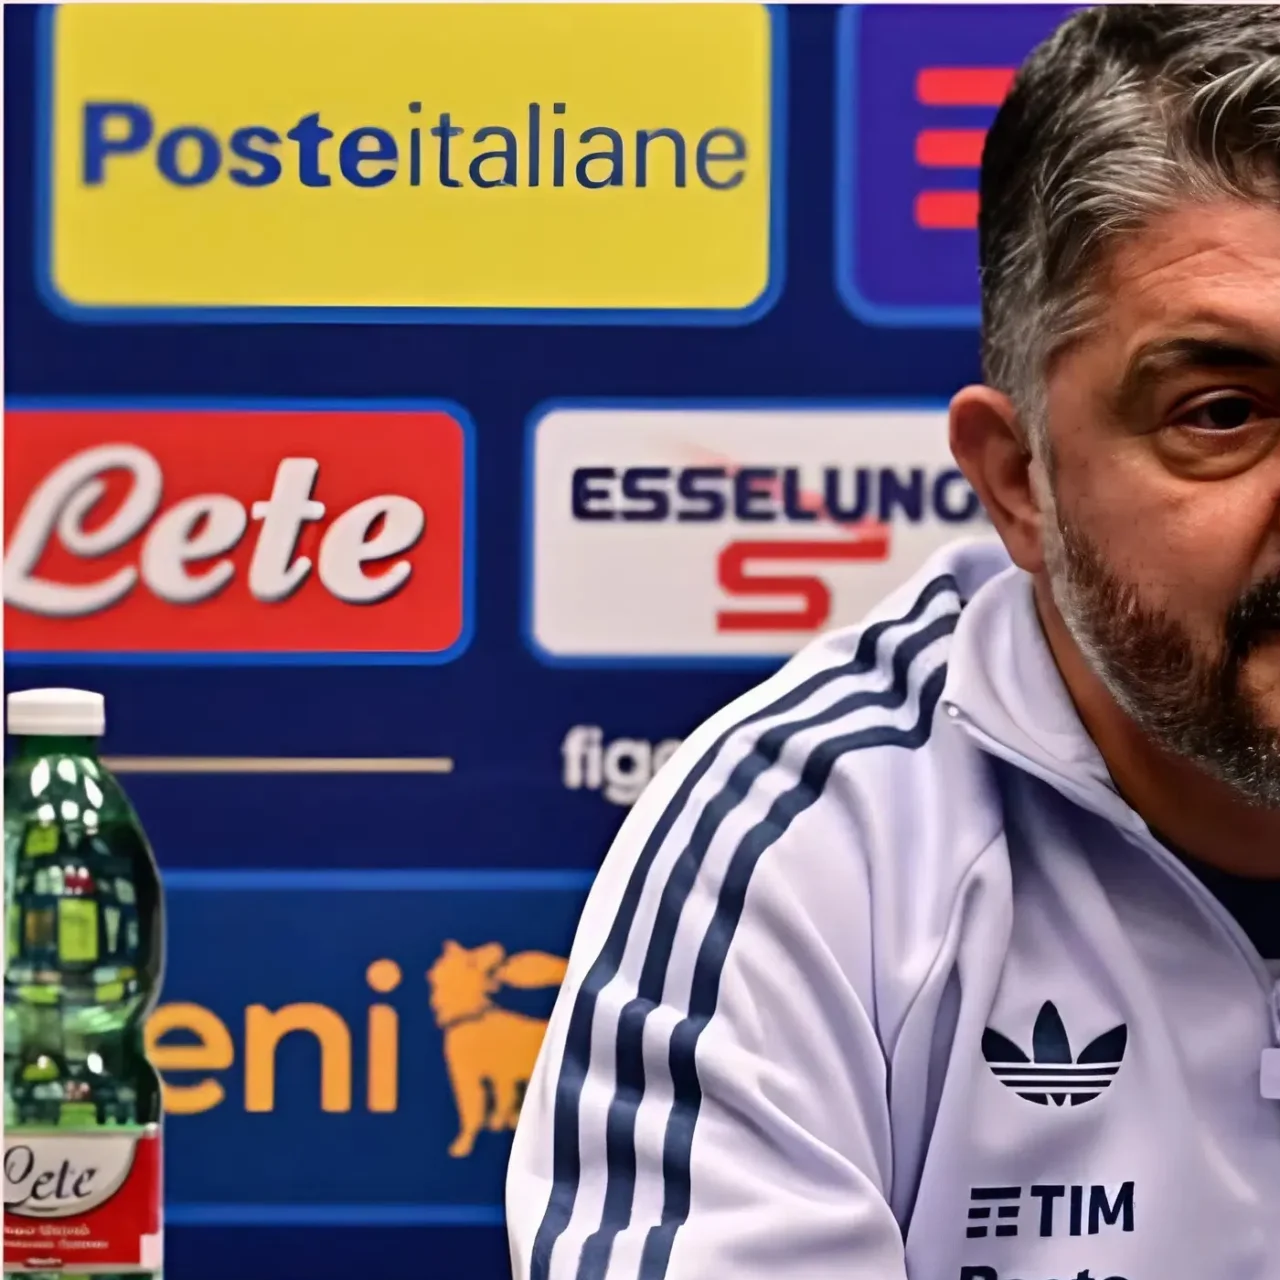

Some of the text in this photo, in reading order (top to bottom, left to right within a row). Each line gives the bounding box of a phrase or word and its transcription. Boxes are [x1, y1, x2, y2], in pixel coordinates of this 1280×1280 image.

[79, 99, 749, 191] Posteitaliane
[3, 442, 426, 619] Lete
[570, 466, 992, 524] ESSELUNG
[142, 958, 403, 1115] eni
[1030, 1180, 1136, 1238] TIM
